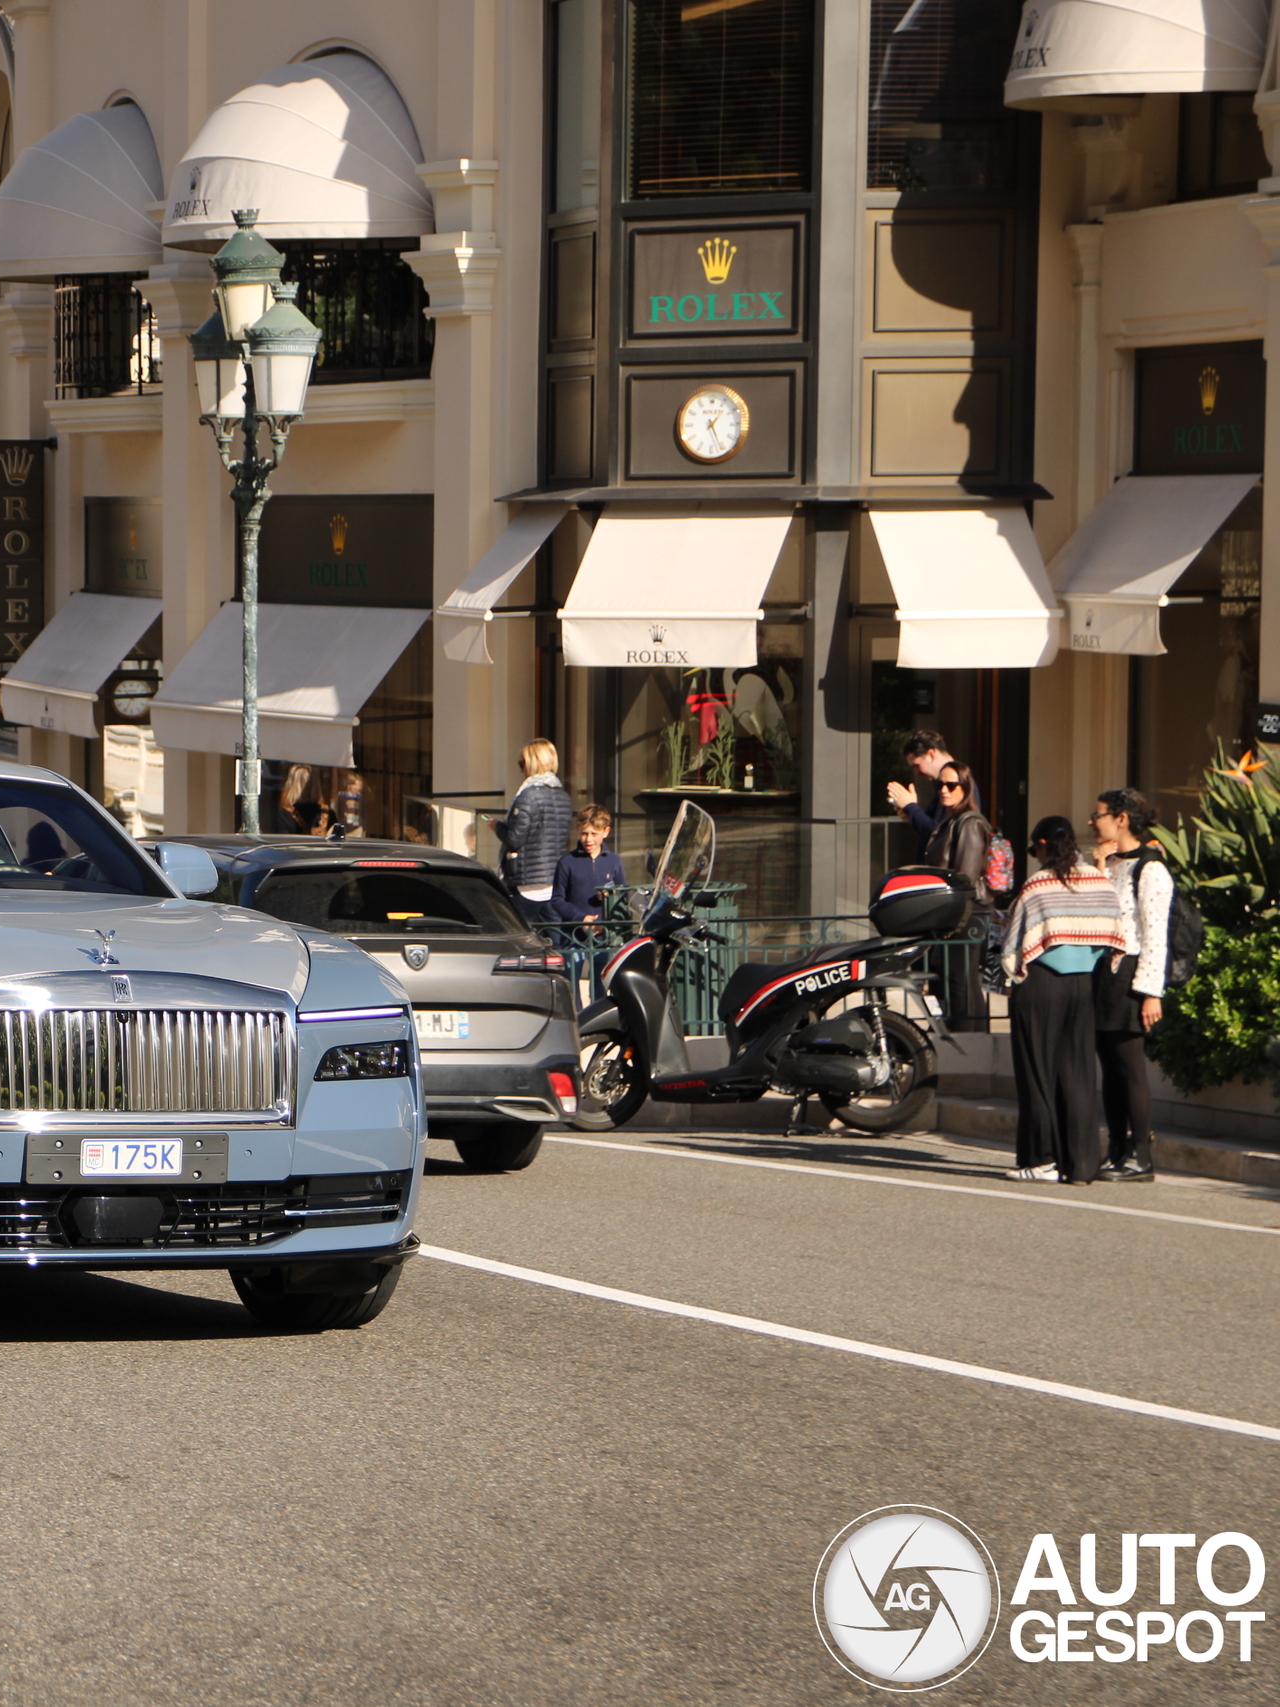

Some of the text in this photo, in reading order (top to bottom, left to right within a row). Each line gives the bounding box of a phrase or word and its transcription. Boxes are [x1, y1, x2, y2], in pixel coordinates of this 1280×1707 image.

[172, 199, 210, 219] ROLEX
[648, 291, 786, 323] ROLEX
[1172, 424, 1243, 455] ROLEX
[3, 496, 31, 657] ROLEX
[308, 562, 369, 588] ROLEX
[1072, 633, 1102, 650] ROLEX
[625, 649, 690, 665] ROLEX
[794, 965, 852, 996] POLICE
[88, 1144, 176, 1170] MC 175K
